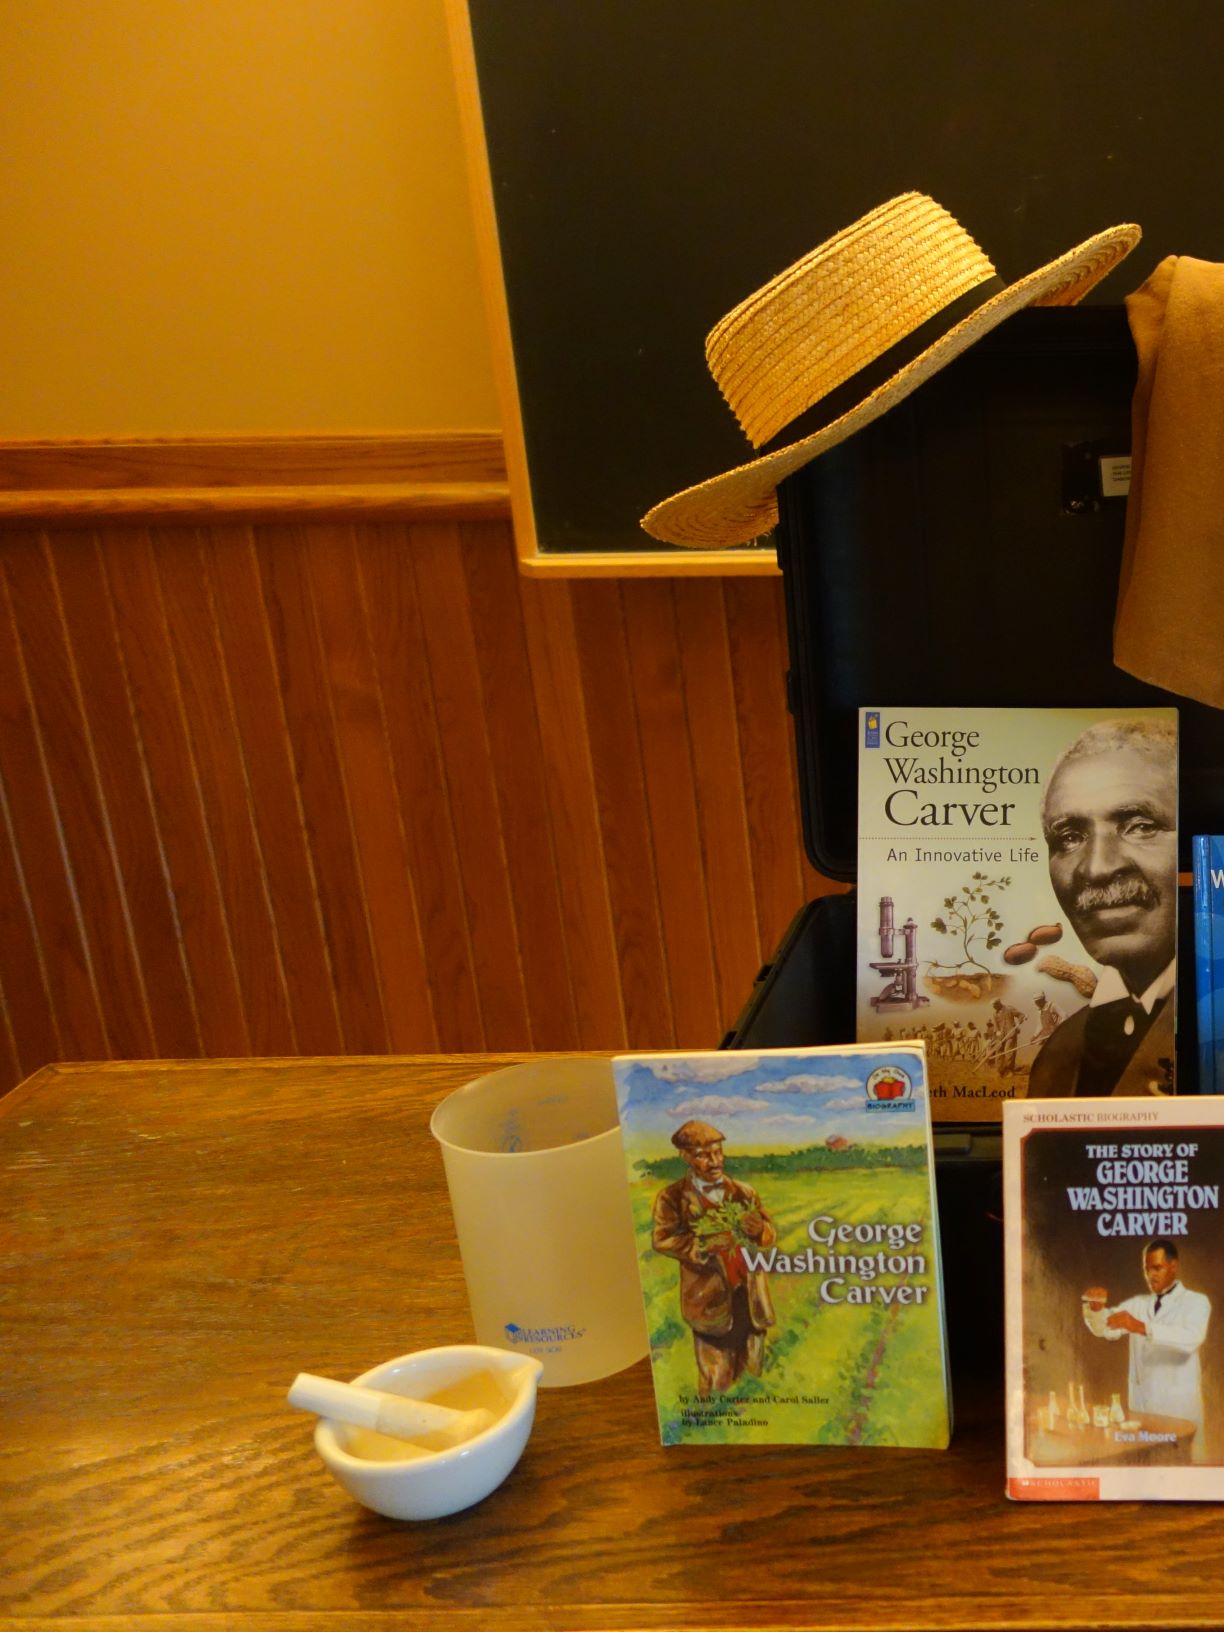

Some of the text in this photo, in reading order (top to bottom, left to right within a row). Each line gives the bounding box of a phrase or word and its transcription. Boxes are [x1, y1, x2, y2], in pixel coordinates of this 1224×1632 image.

[885, 720, 980, 757] George
[883, 756, 1040, 793] Washington
[884, 789, 1015, 826] Carver
[887, 848, 1039, 862] An Innovative Life
[953, 1085, 1015, 1098] MacLeod
[1023, 1111, 1159, 1123] SCHOLASTIC BIOGRAPHY
[1085, 1143, 1199, 1159] THE STORY OF
[1096, 1160, 1189, 1185] GEORGE
[1066, 1185, 1219, 1211] WASHINGTON
[808, 1216, 922, 1250] George
[1096, 1212, 1189, 1237] CARVER
[740, 1247, 925, 1281] Washington
[820, 1278, 928, 1304] Carver
[753, 1395, 770, 1404] and
[773, 1395, 799, 1404] Carol
[802, 1395, 830, 1404] Saller
[727, 1418, 769, 1426] Paladino
[1114, 1430, 1177, 1442] Eva Moore
